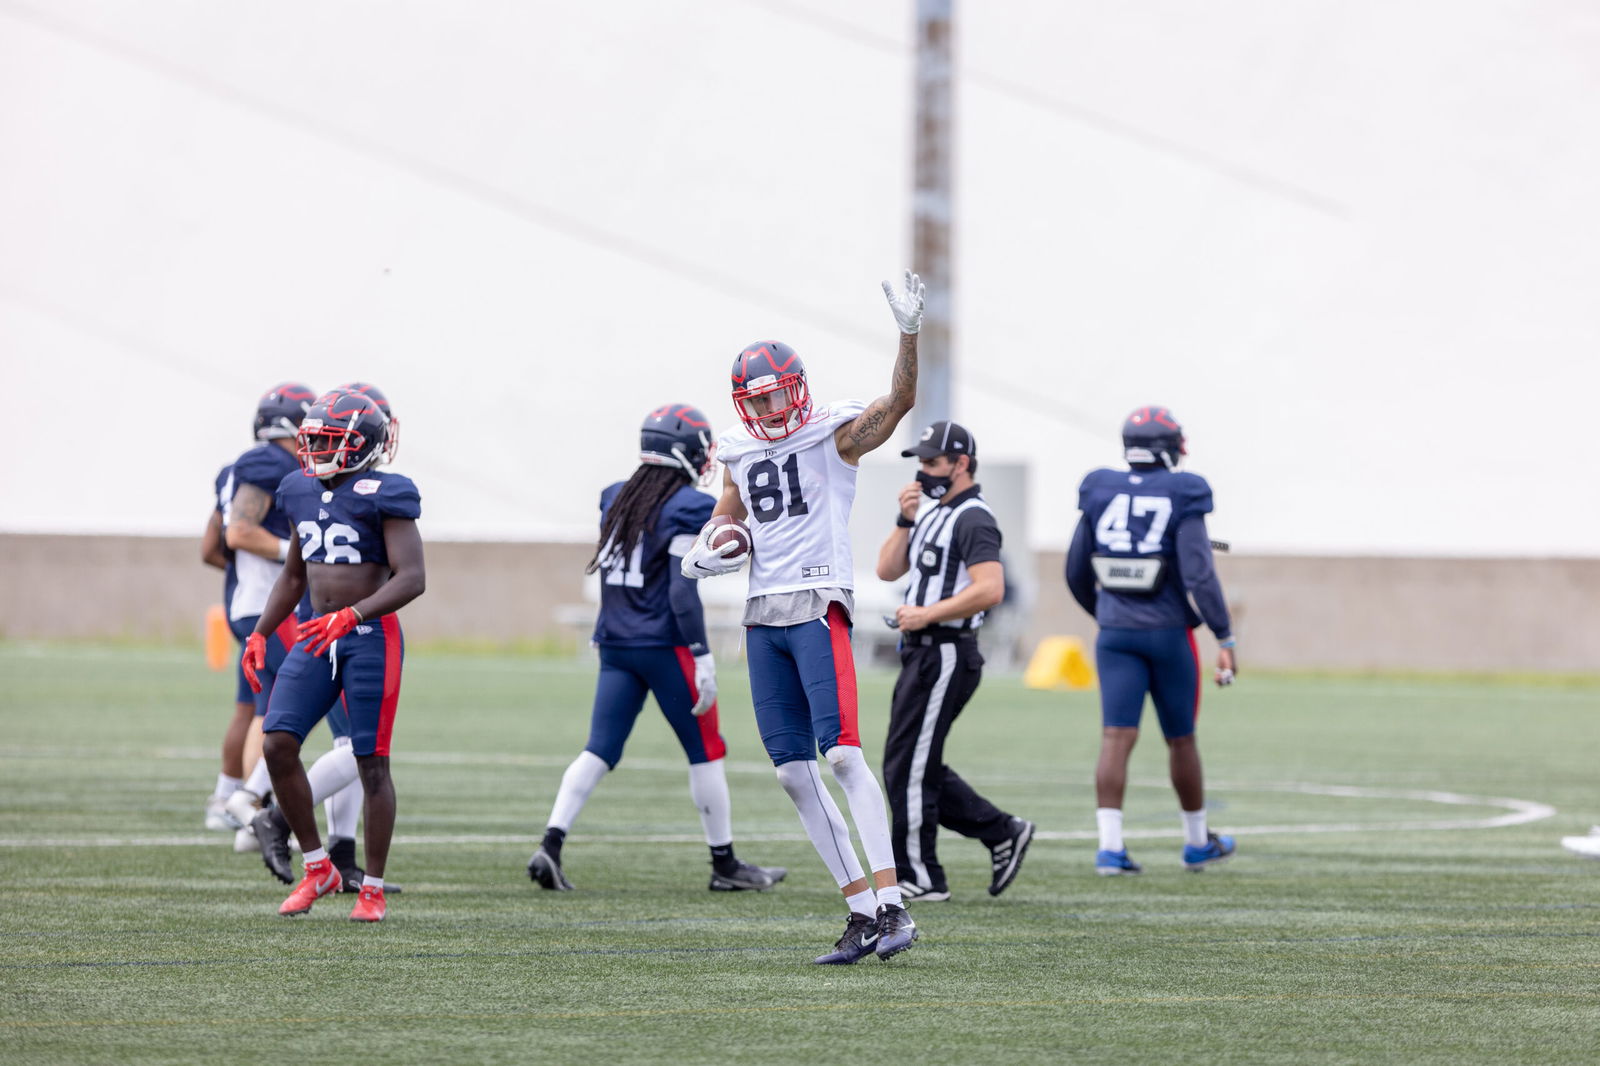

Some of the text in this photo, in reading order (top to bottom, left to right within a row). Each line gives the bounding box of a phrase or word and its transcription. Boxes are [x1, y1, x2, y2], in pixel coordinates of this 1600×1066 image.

[747, 453, 808, 524] 81
[297, 521, 361, 564] 26
[1095, 493, 1173, 553] 47
